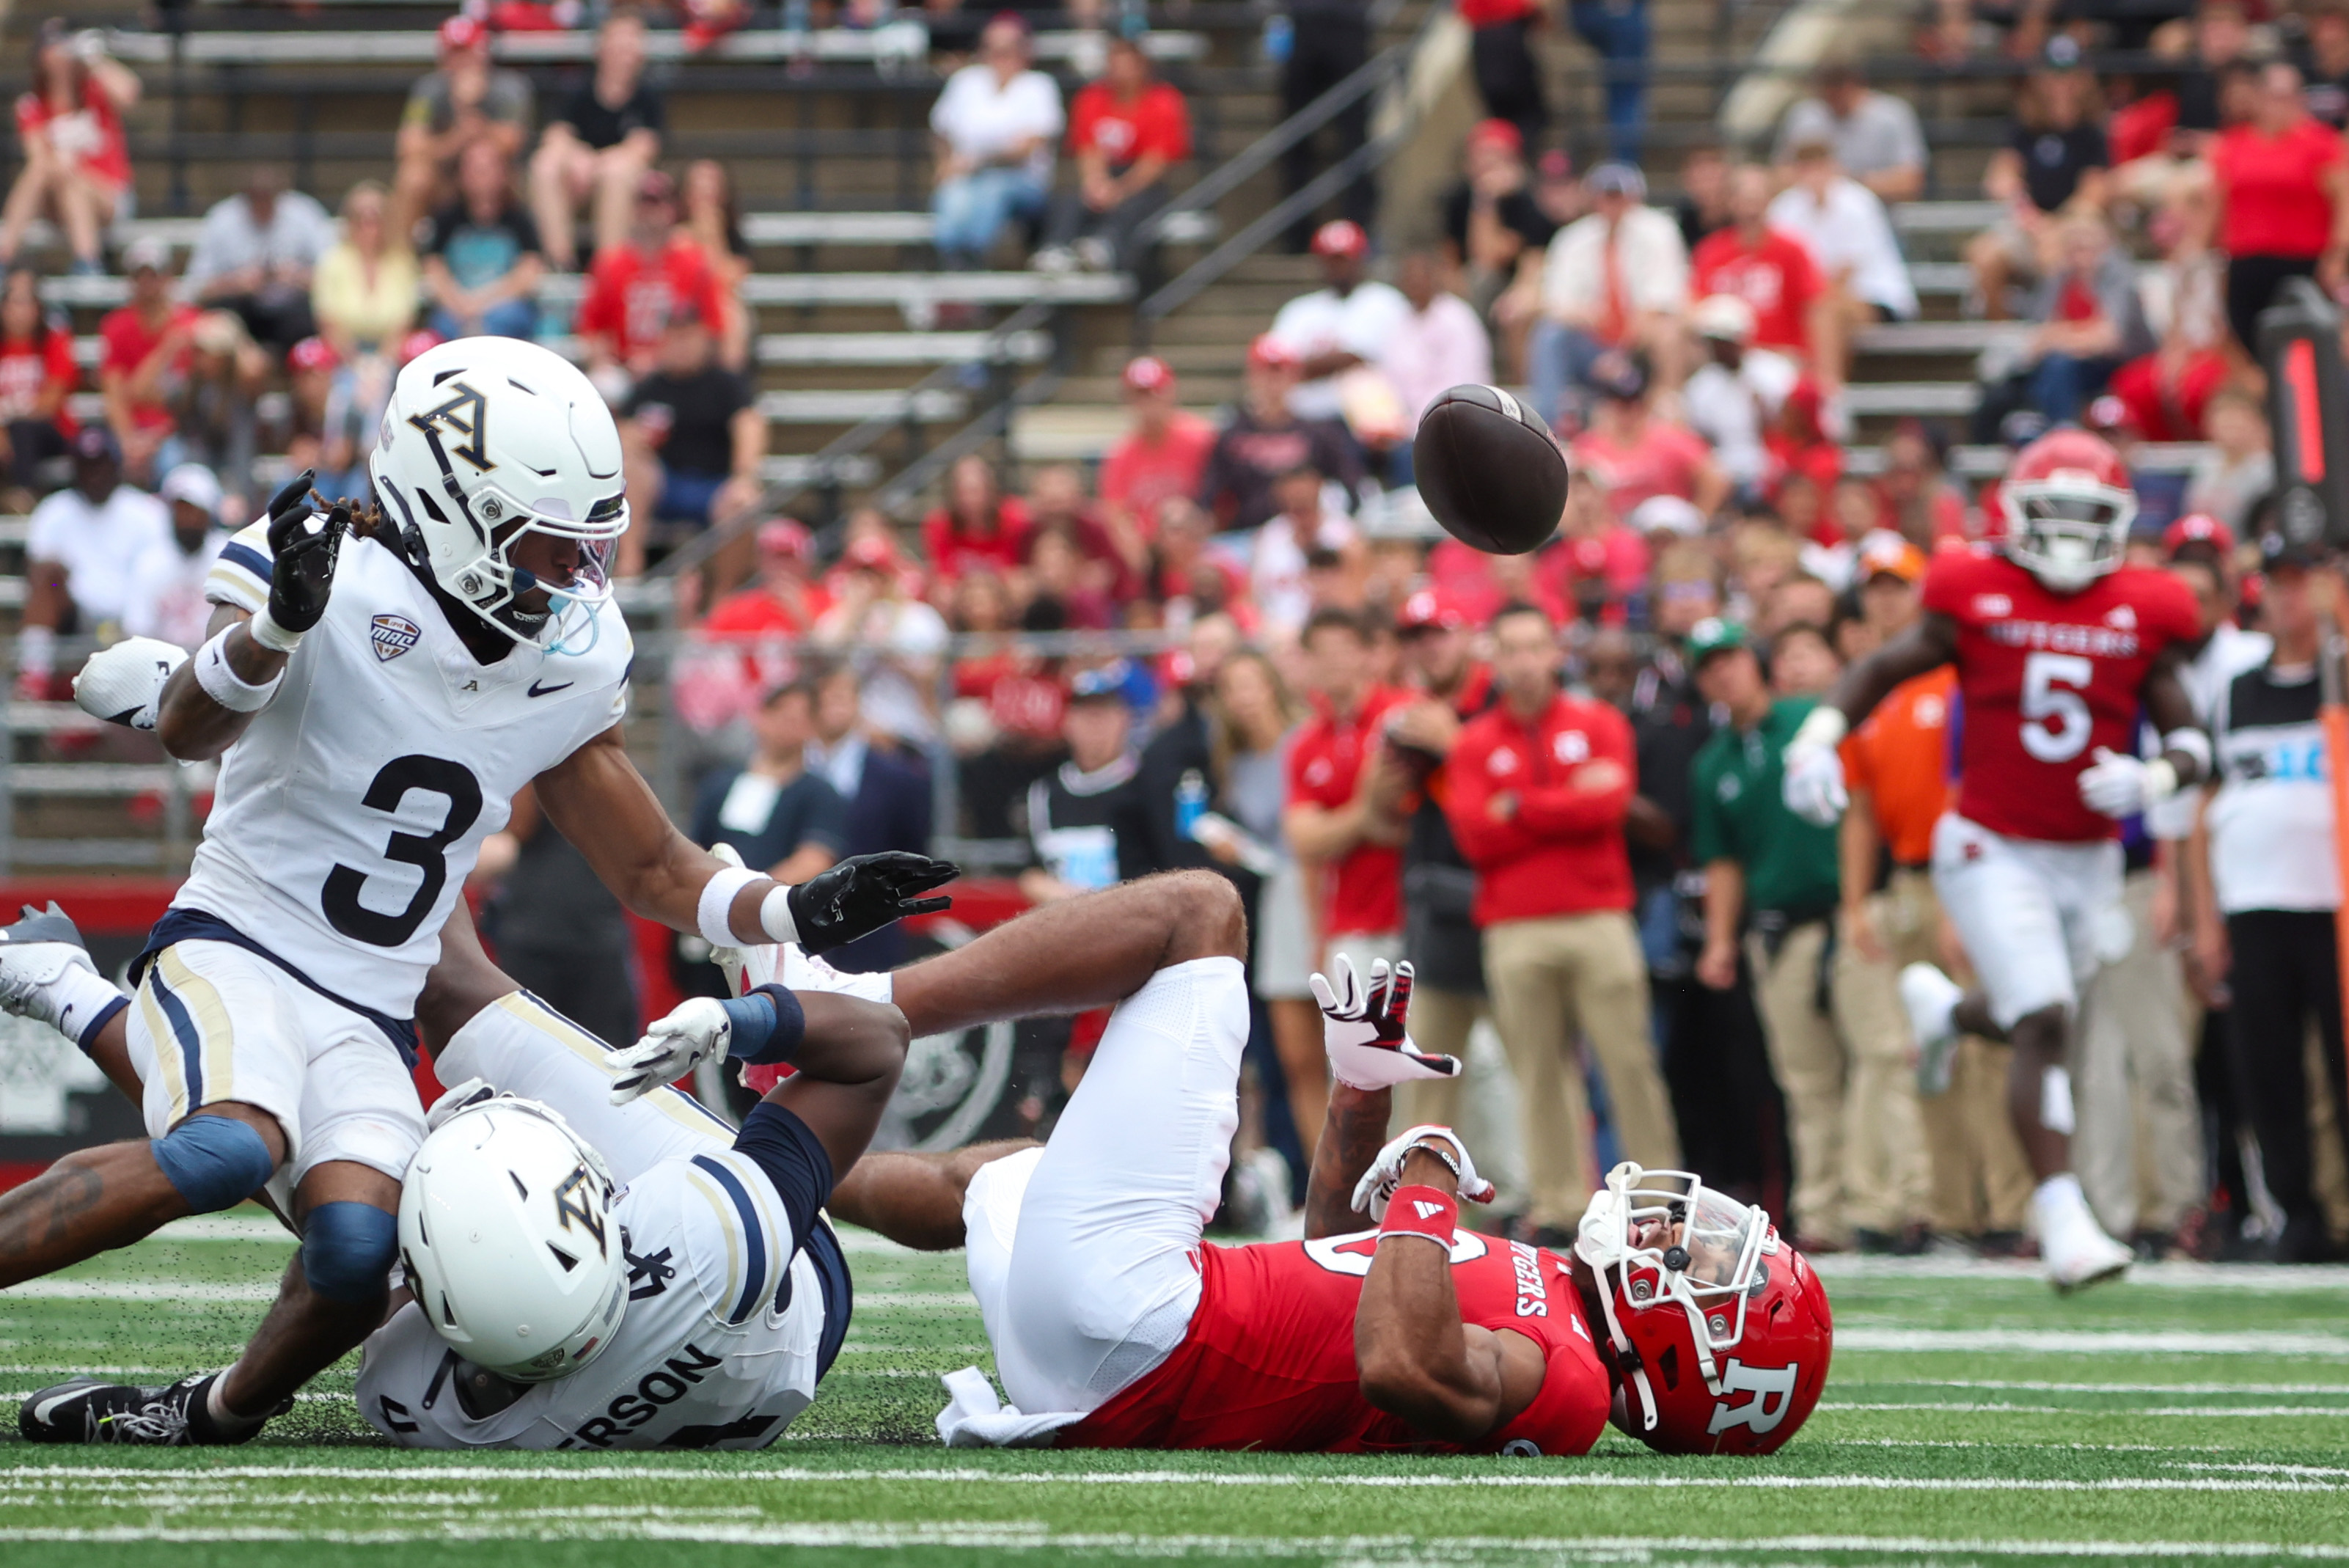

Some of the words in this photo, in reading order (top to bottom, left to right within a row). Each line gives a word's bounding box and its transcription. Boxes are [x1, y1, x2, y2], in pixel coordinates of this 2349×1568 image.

[406, 381, 498, 473] A
[370, 626, 416, 649] MAC
[461, 679, 479, 692] A
[2019, 651, 2094, 763] 5
[321, 754, 483, 947] 3
[1705, 1357, 1799, 1435] R
